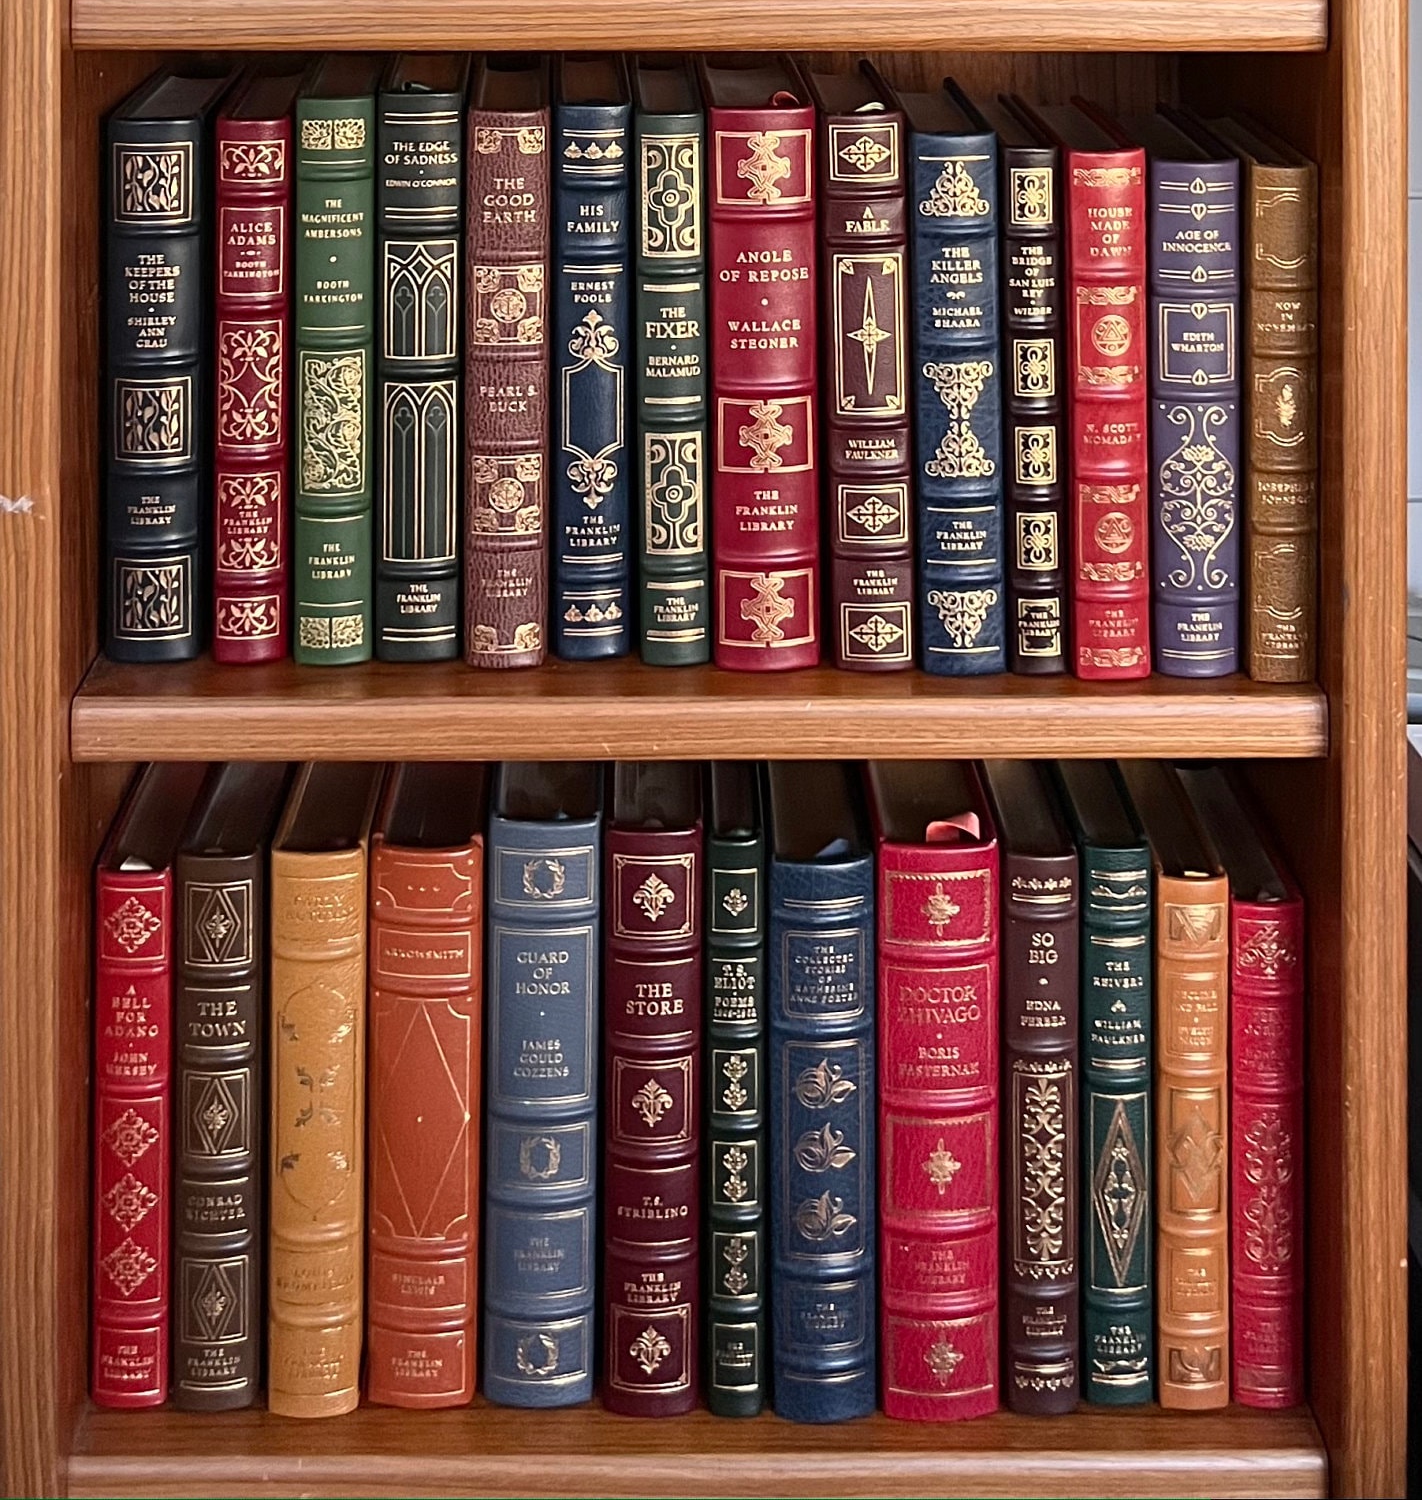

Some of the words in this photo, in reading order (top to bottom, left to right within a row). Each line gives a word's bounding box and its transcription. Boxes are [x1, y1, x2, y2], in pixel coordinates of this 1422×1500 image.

[393, 142, 416, 152] THE
[419, 141, 450, 152] EDGE
[384, 154, 400, 164] OF
[404, 153, 458, 165] SADNESS
[493, 177, 525, 190] THE
[325, 199, 342, 208] THE
[484, 193, 535, 207] GOOD
[580, 205, 604, 216] HIS
[863, 207, 874, 219] A
[302, 212, 364, 223] MAGNIFICENT
[483, 210, 536, 223] EARTH
[231, 222, 273, 233] ALICE
[567, 221, 619, 233] FAMILY
[846, 220, 890, 233] FABLE
[306, 228, 362, 238] AMBERSONS
[1175, 231, 1201, 240] AGE
[1204, 230, 1219, 240] OF
[228, 234, 276, 245] ADAMS
[942, 247, 970, 258] THE
[1163, 242, 1231, 253] INNOCENCE
[138, 254, 164, 265] THE
[737, 250, 793, 263] ANGLE
[932, 260, 981, 271] KILLER
[125, 266, 180, 277] KEEPERS
[720, 270, 740, 282] OF
[749, 267, 808, 282] REPOSE
[930, 272, 983, 284] ANGELS
[129, 280, 146, 290] OF
[148, 279, 175, 290] THE
[130, 292, 175, 303] HOUSE
[660, 307, 686, 318] THE
[128, 316, 176, 326] SHIRLEY
[728, 319, 801, 332] WALLACE
[139, 327, 165, 337] ANN
[646, 321, 700, 338] FIXER
[731, 337, 798, 349] STEGNER
[649, 355, 699, 366] BERNARD
[646, 366, 700, 377] MALAMUD
[754, 490, 779, 500] THE
[736, 505, 798, 515] FRANKLIN
[740, 520, 794, 531] LIBRARY
[1032, 933, 1054, 947] SO
[517, 951, 569, 964] GUARD
[1029, 950, 1058, 964] BIG
[533, 967, 552, 979] OF
[516, 982, 570, 995] HONOR
[714, 976, 755, 990] ELIOT
[636, 983, 672, 998] THE
[901, 986, 977, 1001] DOCTOR
[627, 999, 683, 1015] STORE
[715, 996, 754, 1008] POEMS
[1026, 1000, 1061, 1011] EDNA
[198, 1001, 237, 1016] THE
[190, 1020, 246, 1036] TOWN
[523, 1039, 561, 1050] JAMES
[520, 1053, 563, 1064] GOULD
[919, 1047, 960, 1059] BORIS
